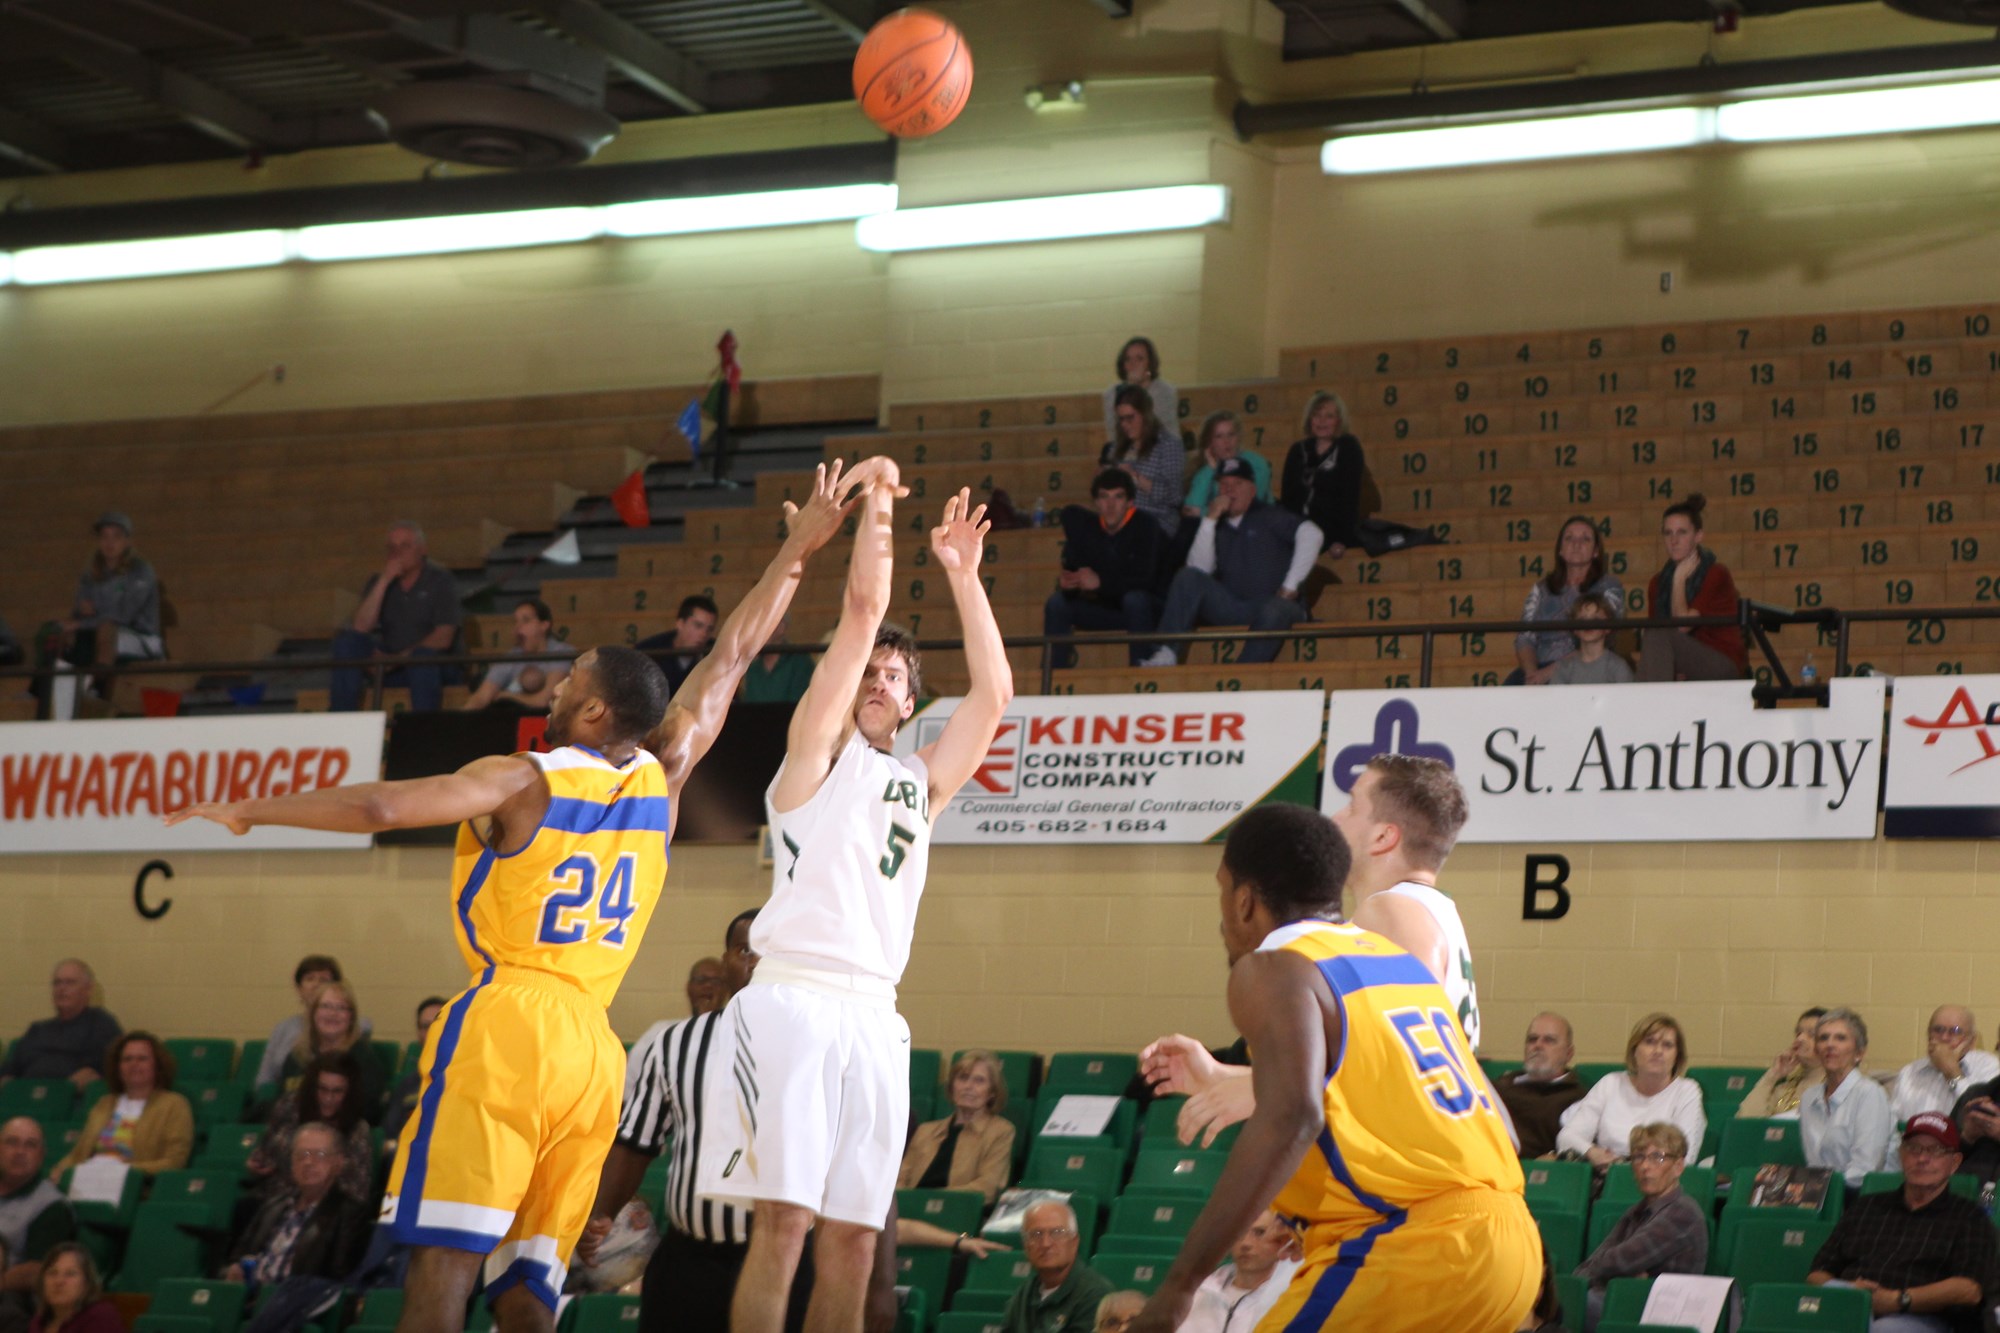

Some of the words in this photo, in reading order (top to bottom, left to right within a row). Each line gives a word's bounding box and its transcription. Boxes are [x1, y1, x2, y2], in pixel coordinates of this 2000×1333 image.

[1309, 360, 1317, 378] 1
[1376, 353, 1389, 373] 2
[1446, 348, 1458, 368] 3
[1516, 344, 1530, 363] 4
[1588, 339, 1602, 359] 5
[1661, 333, 1676, 352] 6
[1738, 329, 1749, 349] 7
[1812, 325, 1826, 345] 8
[1889, 320, 1904, 341] 9
[1965, 315, 1989, 336] 10
[1244, 393, 1258, 413] 6
[1384, 386, 1397, 405] 8
[1455, 381, 1469, 401] 9
[1525, 376, 1548, 397] 10
[1600, 372, 1617, 393] 11
[1674, 367, 1695, 388] 12
[1751, 363, 1774, 384] 13
[1828, 360, 1851, 380] 14
[1907, 355, 1932, 376] 15
[979, 409, 992, 428] 2
[1044, 405, 1056, 425] 3
[1253, 427, 1264, 446] 7
[1394, 419, 1408, 439] 9
[1465, 414, 1488, 434] 10
[1540, 411, 1559, 431] 11
[1616, 406, 1638, 426] 12
[1692, 402, 1716, 422] 13
[1772, 398, 1795, 418] 14
[1853, 393, 1876, 414] 15
[1933, 388, 1958, 410] 16
[915, 444, 927, 463] 2
[981, 441, 993, 461] 3
[1047, 438, 1059, 457] 4
[1403, 453, 1427, 473] 10
[1479, 450, 1498, 470] 11
[1554, 446, 1577, 467] 12
[1633, 441, 1656, 463] 13
[1712, 439, 1735, 459] 14
[1793, 434, 1817, 455] 15
[1876, 428, 1900, 450] 16
[1960, 424, 1984, 447] 17
[913, 477, 926, 497] 3
[1049, 471, 1062, 491] 5
[1413, 489, 1431, 509] 11
[1489, 485, 1511, 506] 12
[1568, 480, 1591, 502] 13
[1649, 478, 1672, 498] 14
[1730, 473, 1755, 495] 15
[1814, 469, 1839, 491] 16
[1899, 466, 1924, 488] 17
[713, 523, 721, 541] 1
[911, 514, 923, 532] 4
[1507, 520, 1530, 541] 13
[1753, 508, 1778, 530] 16
[1840, 504, 1863, 526] 17
[1927, 501, 1952, 523] 18
[711, 554, 723, 574] 2
[914, 546, 927, 567] 5
[983, 544, 998, 563] 6
[1358, 562, 1380, 582] 12
[1437, 559, 1461, 580] 13
[1519, 556, 1543, 577] 14
[1774, 544, 1798, 566] 17
[1861, 540, 1887, 563] 18
[1951, 538, 1978, 560] 19
[635, 590, 647, 610] 2
[910, 579, 924, 599] 6
[1367, 598, 1391, 619] 13
[1450, 596, 1474, 617] 14
[1795, 583, 1821, 606] 18
[1885, 580, 1912, 603] 19
[909, 614, 922, 635] 7
[1212, 639, 1235, 663] 12
[1294, 636, 1317, 661] 13
[1376, 634, 1400, 659] 14
[1460, 632, 1486, 656] 15
[1907, 619, 1945, 644] 20
[1028, 711, 1246, 745] KINSER
[1024, 749, 1245, 768] CONSTRUCTION
[1480, 727, 1554, 794] St.
[1566, 719, 1874, 811] Anthony
[2, 747, 349, 820] WHATABURGER
[1022, 771, 1157, 788] COMPANY
[960, 801, 1060, 814] Commercial
[1067, 800, 1133, 812] General
[1138, 798, 1243, 812] Contractors
[879, 821, 916, 880] 5
[134, 859, 174, 920] C
[534, 851, 639, 949] 24
[1522, 854, 1571, 920] B
